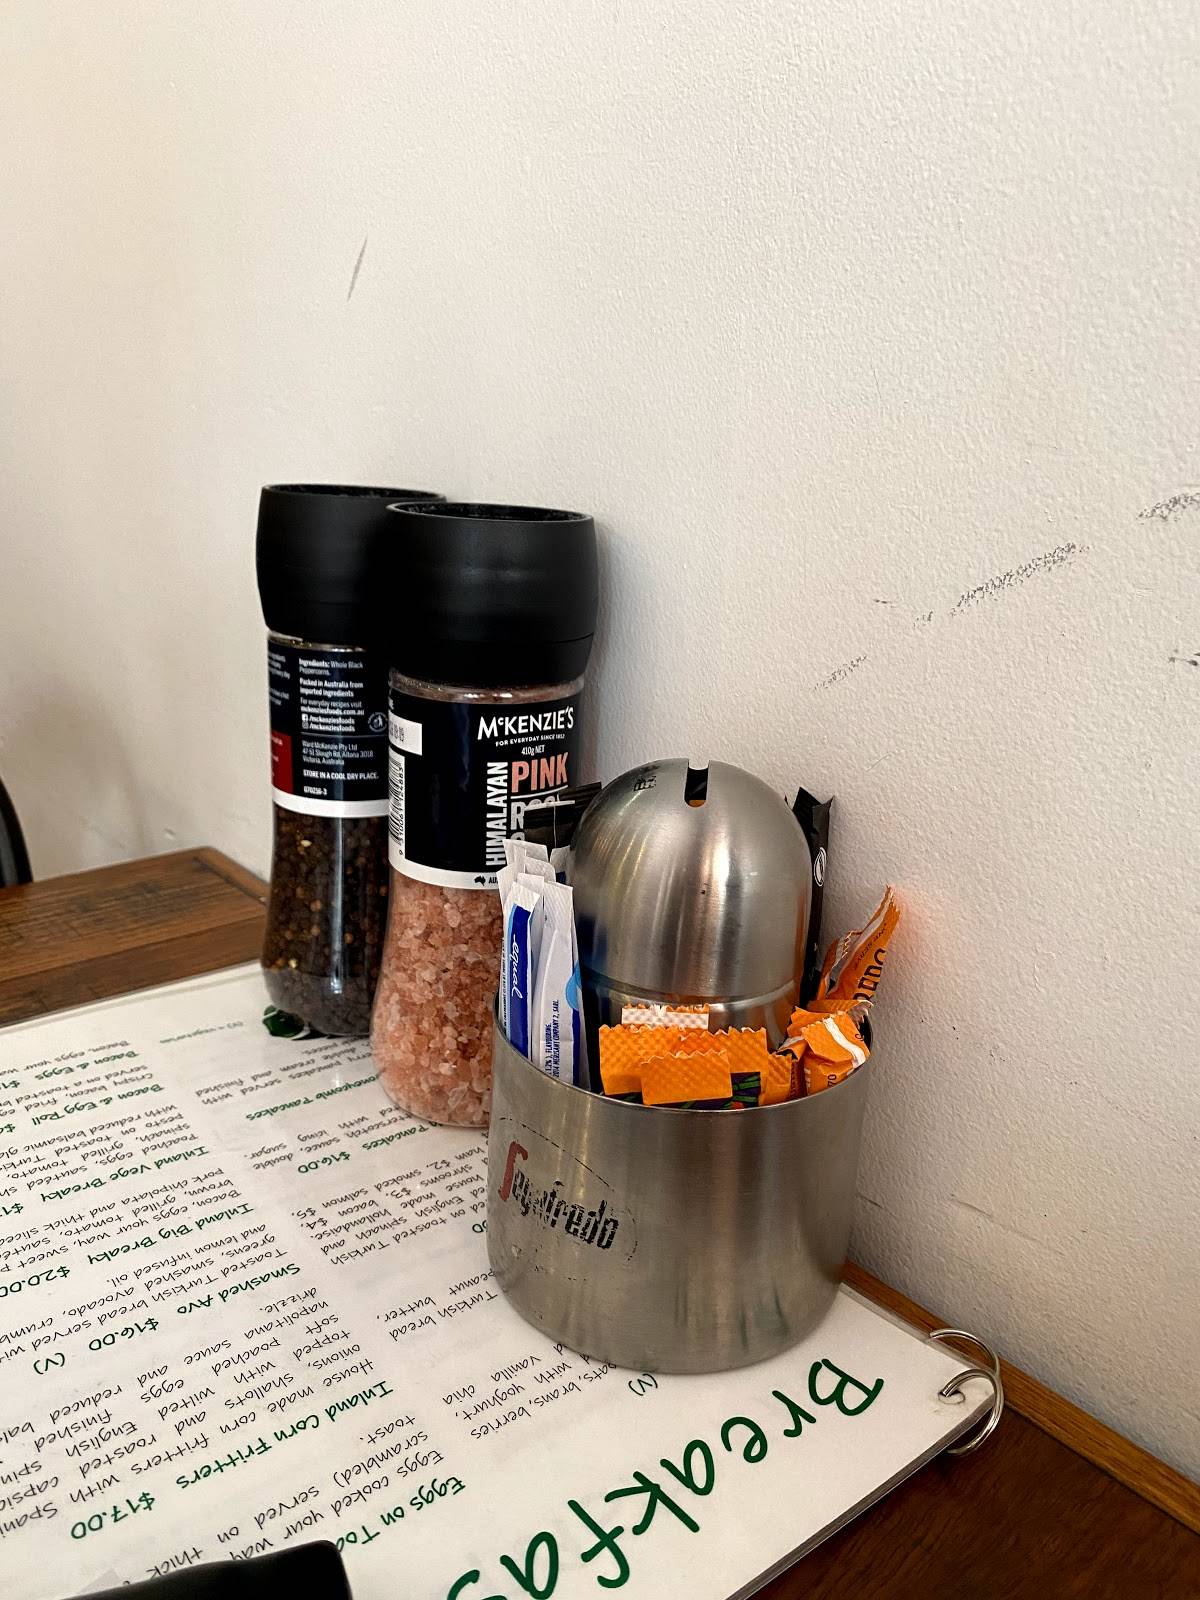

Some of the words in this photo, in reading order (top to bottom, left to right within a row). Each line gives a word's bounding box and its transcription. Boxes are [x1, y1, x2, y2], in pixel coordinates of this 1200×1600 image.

[300, 678, 317, 688] Packed
[318, 679, 323, 688] in
[324, 680, 349, 689] Australia
[349, 681, 364, 689] from
[510, 735, 539, 745] EVERYDAY
[521, 745, 535, 756] 410g
[535, 744, 546, 754] NET
[360, 750, 374, 758] 3018
[303, 769, 319, 779] STORE
[320, 771, 326, 779] IN
[331, 772, 346, 780] COOL
[347, 772, 358, 780] DRY
[511, 751, 569, 794] PINK
[485, 762, 508, 866] HIMALAYAN
[510, 934, 523, 999] equal
[94, 1051, 140, 1064] Bacon
[35, 1067, 75, 1080] Eggs
[117, 1084, 165, 1099] Bacon
[32, 1112, 66, 1125] Roll
[64, 1102, 99, 1114] Egg
[246, 1097, 314, 1120] Pancakes
[142, 1134, 199, 1156] Poached
[300, 1137, 341, 1153] sauce,
[362, 1125, 430, 1150] Pancakes
[96, 1152, 134, 1165] eggs,
[154, 1146, 210, 1169] Inland
[253, 1153, 294, 1169] double
[298, 1152, 351, 1173] $16.00
[455, 1147, 486, 1160] ham
[27, 1166, 88, 1190] sautéed
[110, 1165, 152, 1180] Vege
[192, 1168, 225, 1183] pork
[374, 1169, 422, 1192] smoked
[420, 1164, 473, 1187] shrooms
[446, 1174, 485, 1192] house
[41, 1178, 108, 1202] Breaky
[121, 1180, 189, 1205] chipolata
[184, 1180, 234, 1196] brown,
[192, 1190, 242, 1206] Bacon,
[322, 1188, 369, 1208] salmon
[400, 1192, 437, 1208] made
[90, 1203, 116, 1218] and
[132, 1195, 176, 1217] grilled
[153, 1206, 189, 1221] eggs
[195, 1203, 255, 1230] Inland
[338, 1200, 380, 1216] bacon
[412, 1196, 465, 1217] English
[450, 1209, 466, 1218] on
[43, 1214, 85, 1230] thick
[60, 1215, 124, 1236] tomato,
[117, 1219, 149, 1234] your
[159, 1225, 194, 1239] Big
[241, 1224, 266, 1240] and
[310, 1209, 392, 1240] hollandaise.
[355, 1216, 408, 1240] spinach
[392, 1217, 447, 1243] toasted
[74, 1233, 111, 1246] way,
[88, 1237, 158, 1264] Breaky
[195, 1236, 239, 1254] lemon
[222, 1234, 275, 1257] greens,
[321, 1239, 346, 1255] and
[18, 1246, 69, 1268] sweet
[221, 1249, 288, 1277] Toasted
[331, 1241, 391, 1264] Turkish
[134, 1252, 193, 1279] infused
[144, 1258, 215, 1291] smashed
[107, 1274, 128, 1287] oil.
[152, 1275, 219, 1301] Turkish
[218, 1264, 301, 1302] Smashed
[449, 1269, 497, 1295] peanut
[63, 1287, 135, 1317] avocado,
[97, 1300, 149, 1325] bread
[177, 1295, 214, 1313] Avo
[260, 1288, 317, 1313] drizzle.
[377, 1297, 437, 1322] butter,
[438, 1291, 498, 1317] Turkish
[244, 1301, 329, 1339] napolitana
[306, 1315, 339, 1334] soft
[389, 1316, 437, 1341] bread
[32, 1320, 92, 1351] served
[89, 1318, 160, 1350] $16.00
[293, 1331, 351, 1361] topped
[34, 1353, 66, 1374] (V)
[184, 1340, 232, 1364] sauce
[212, 1337, 281, 1376] poached
[308, 1345, 361, 1369] onions,
[137, 1366, 169, 1388] and
[234, 1362, 277, 1383] with
[323, 1359, 374, 1386] House
[491, 1356, 542, 1381] vanilla
[534, 1363, 573, 1383] with
[141, 1380, 185, 1403] eggs
[225, 1373, 294, 1409] shallots
[443, 1385, 476, 1404] chia
[529, 1382, 582, 1407] brans,
[628, 1374, 659, 1396] (V)
[50, 1385, 123, 1424] reduced
[158, 1388, 216, 1421] wilted
[267, 1386, 315, 1412] made
[325, 1381, 394, 1422] Inland
[456, 1384, 526, 1420] yoghurt,
[34, 1409, 113, 1452] finished
[175, 1412, 207, 1436] and
[220, 1412, 256, 1433] corn
[274, 1415, 320, 1441] Corn
[360, 1416, 416, 1443] toast.
[471, 1407, 532, 1439] berries
[66, 1422, 138, 1457] English
[79, 1434, 157, 1479] roasted
[131, 1433, 210, 1474] fritters
[176, 1437, 273, 1488] Fritters
[334, 1431, 429, 1487] scrambled)
[397, 1451, 445, 1477] Eggs
[70, 1475, 121, 1502] with
[331, 1476, 389, 1517] cooked
[410, 1477, 466, 1510] Eggs
[71, 1492, 156, 1539] $17.00
[254, 1486, 320, 1530] served
[380, 1507, 405, 1525] on
[217, 1527, 240, 1543] on
[284, 1510, 325, 1539] your
[146, 1546, 204, 1580] thick
